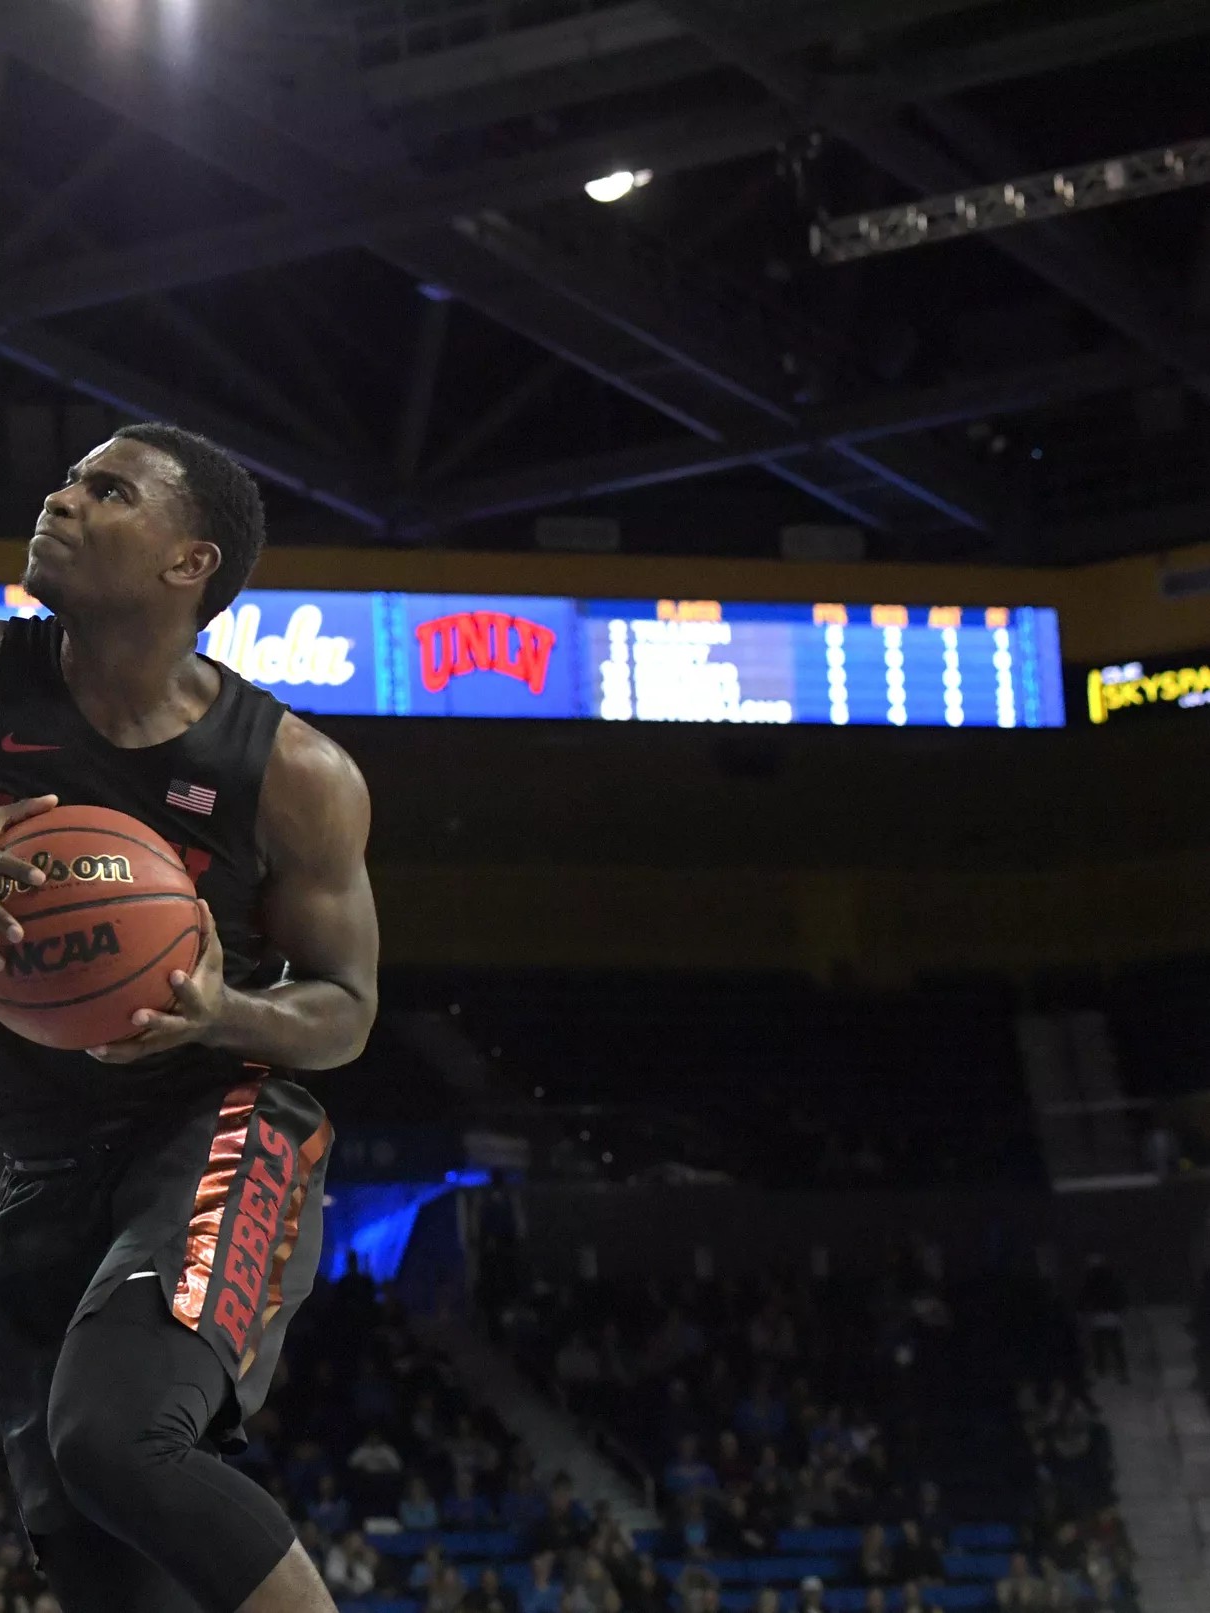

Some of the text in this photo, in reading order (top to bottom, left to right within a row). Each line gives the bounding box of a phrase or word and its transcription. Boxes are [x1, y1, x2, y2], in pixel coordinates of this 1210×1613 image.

[416, 611, 556, 694] UNLV
[5, 921, 120, 976] NCAA
[214, 1117, 295, 1355] REBELS
